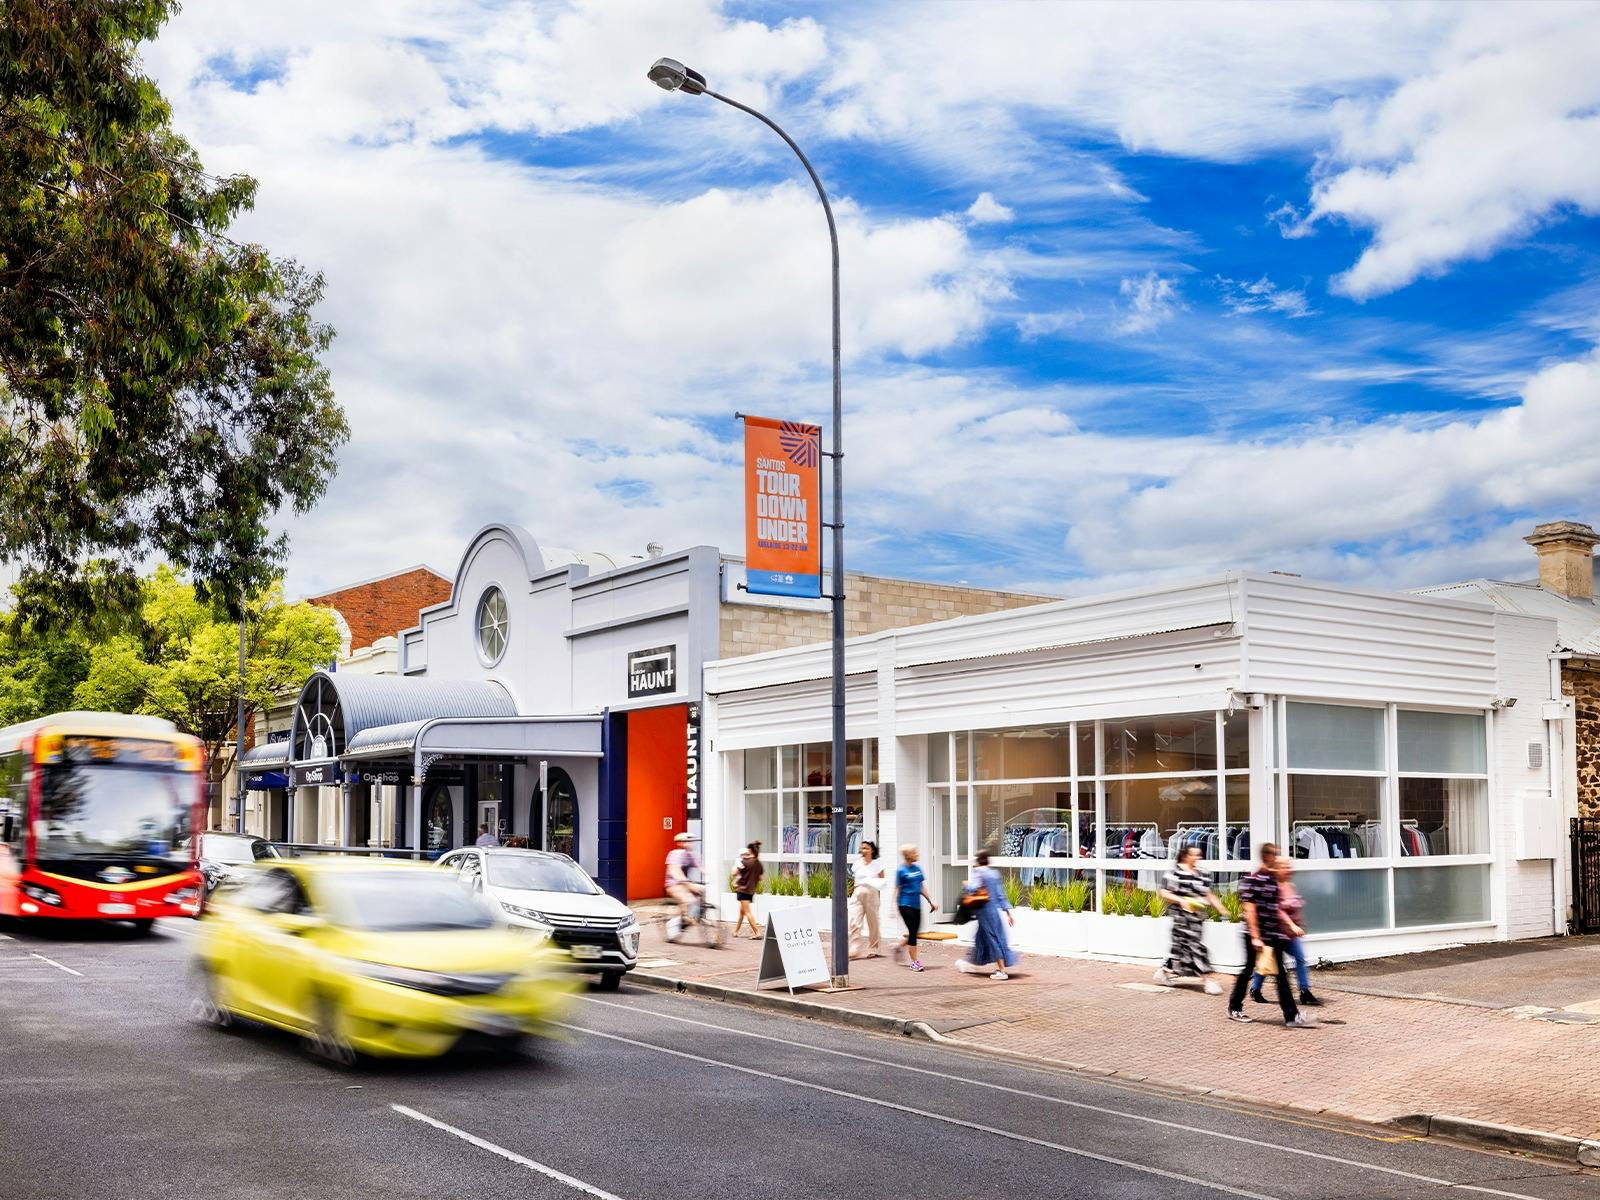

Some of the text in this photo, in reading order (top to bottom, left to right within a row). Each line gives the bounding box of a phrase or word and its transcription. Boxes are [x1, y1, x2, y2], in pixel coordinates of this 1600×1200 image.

[756, 457, 786, 471] SANTOS
[756, 469, 801, 497] TOUR
[756, 494, 807, 521] DOWN
[757, 518, 808, 544] UNDER
[631, 669, 674, 691] HAUNT
[687, 723, 697, 809] HAUNT
